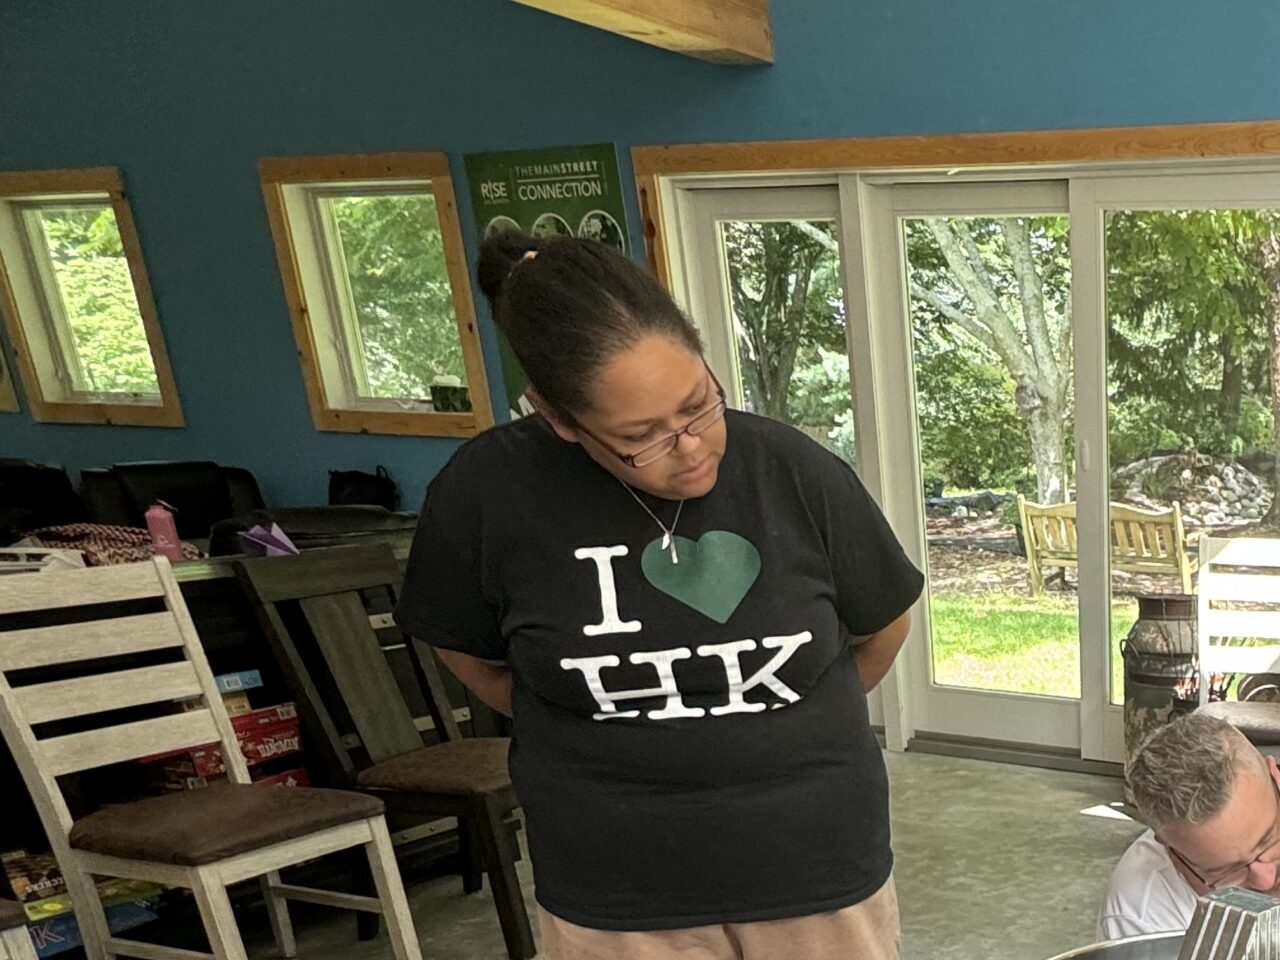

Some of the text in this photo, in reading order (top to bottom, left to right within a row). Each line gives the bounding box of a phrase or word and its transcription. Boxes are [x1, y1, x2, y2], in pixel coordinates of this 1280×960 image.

[481, 180, 508, 199] RISE
[518, 180, 602, 200] CONNECTION
[574, 545, 642, 636] I
[560, 631, 813, 720] HK
